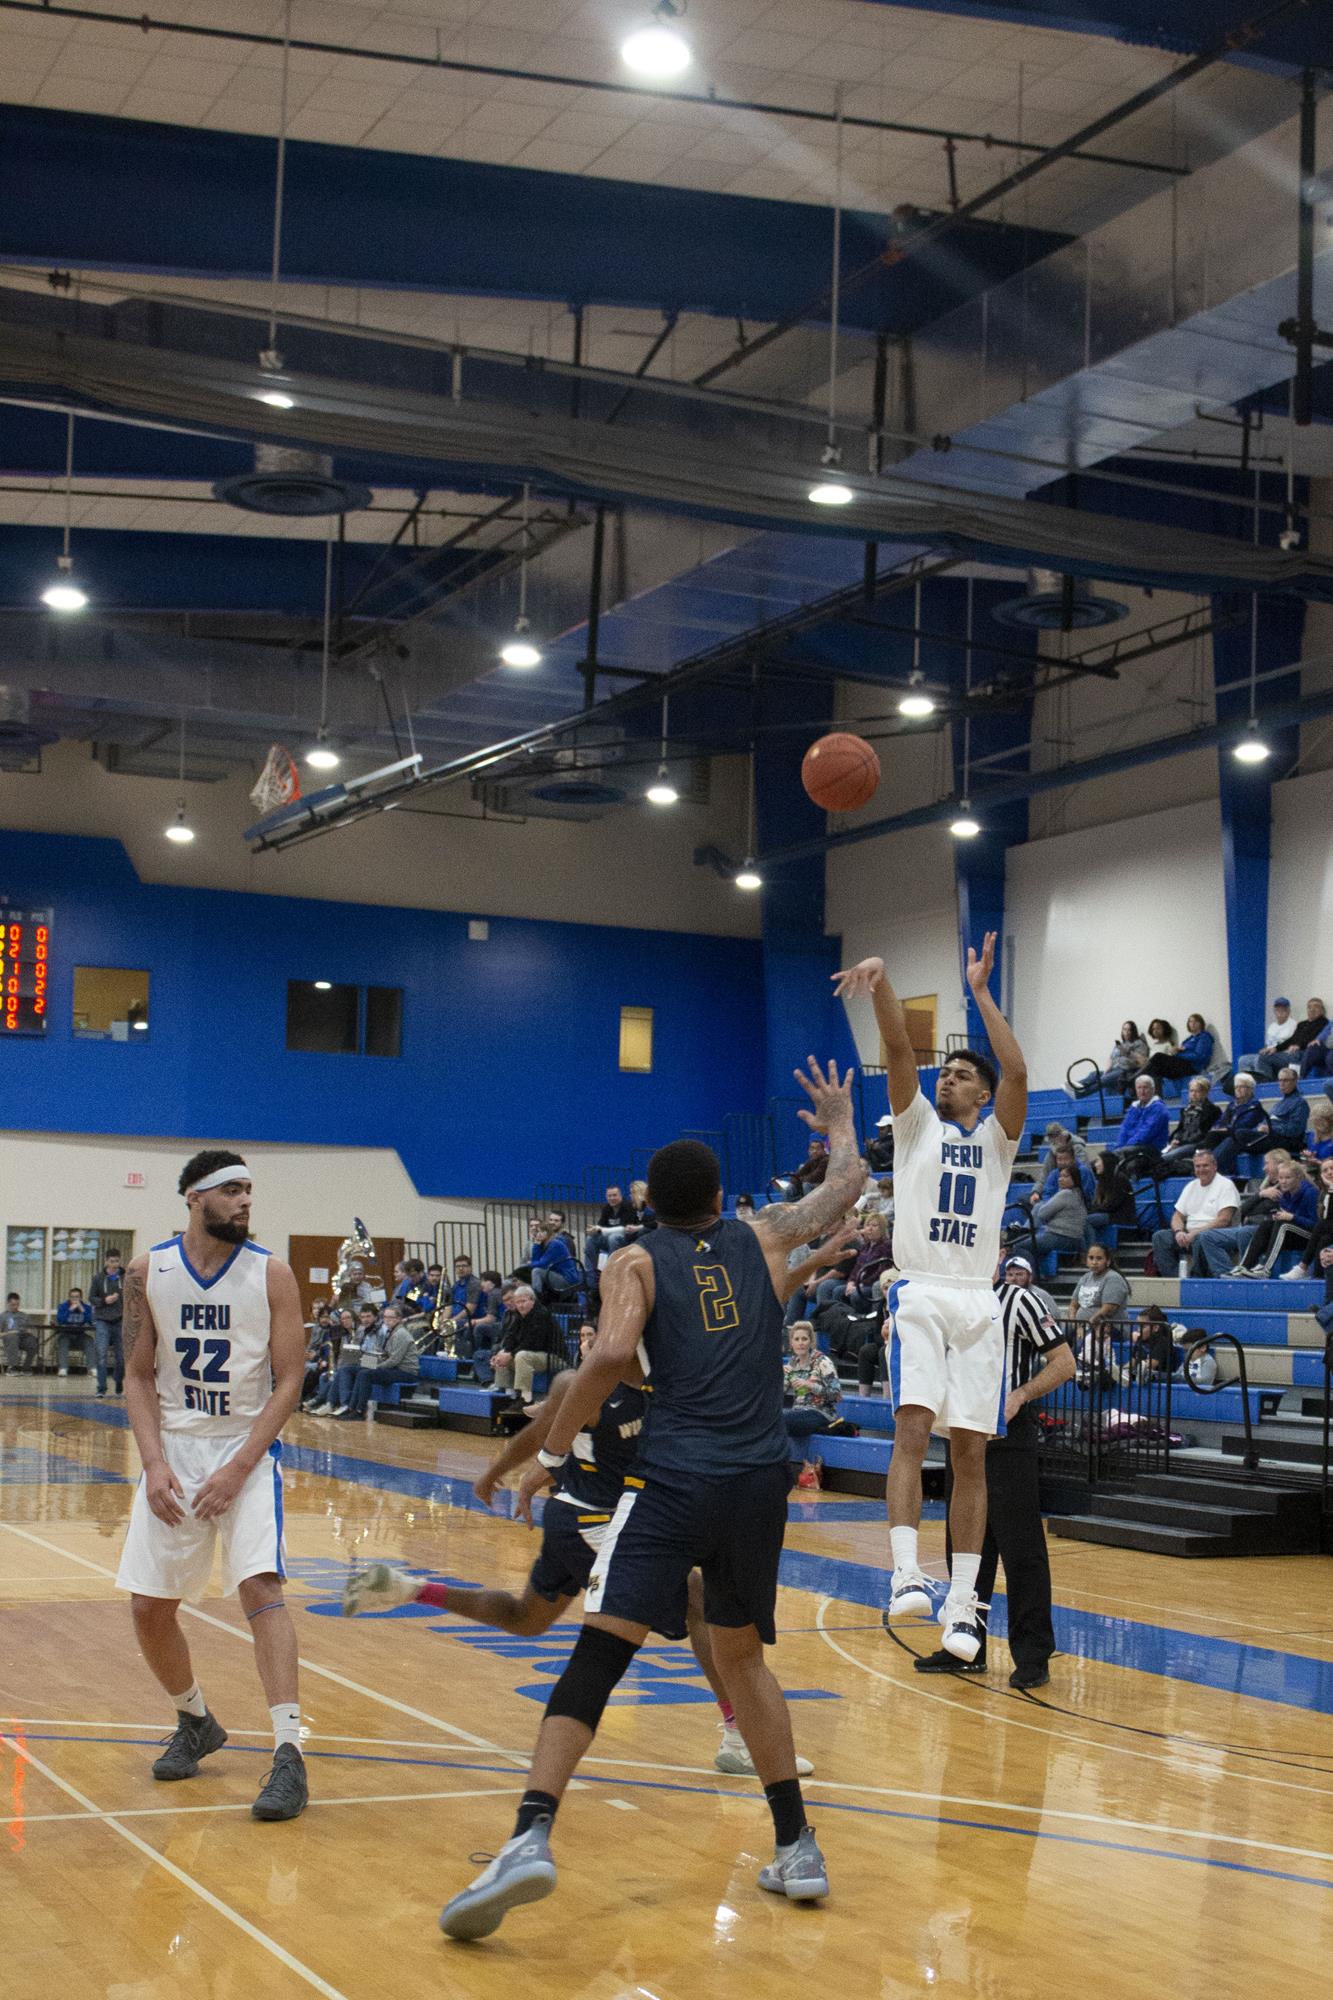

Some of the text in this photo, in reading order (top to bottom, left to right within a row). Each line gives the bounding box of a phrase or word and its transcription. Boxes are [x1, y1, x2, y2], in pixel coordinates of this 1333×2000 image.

[10, 925, 47, 942] 0 0
[9, 944, 47, 959] 2 0
[14, 962, 46, 977] 1 0
[9, 978, 45, 995] 0 2
[7, 997, 45, 1013] 0 2
[7, 1014, 16, 1028] 6
[941, 1142, 983, 1169] PERU
[938, 1171, 976, 1217] 10
[929, 1217, 978, 1248] STATE
[693, 1264, 740, 1332] 2
[181, 1303, 231, 1330] PERU
[175, 1337, 231, 1383] 22
[184, 1384, 230, 1416] STATE
